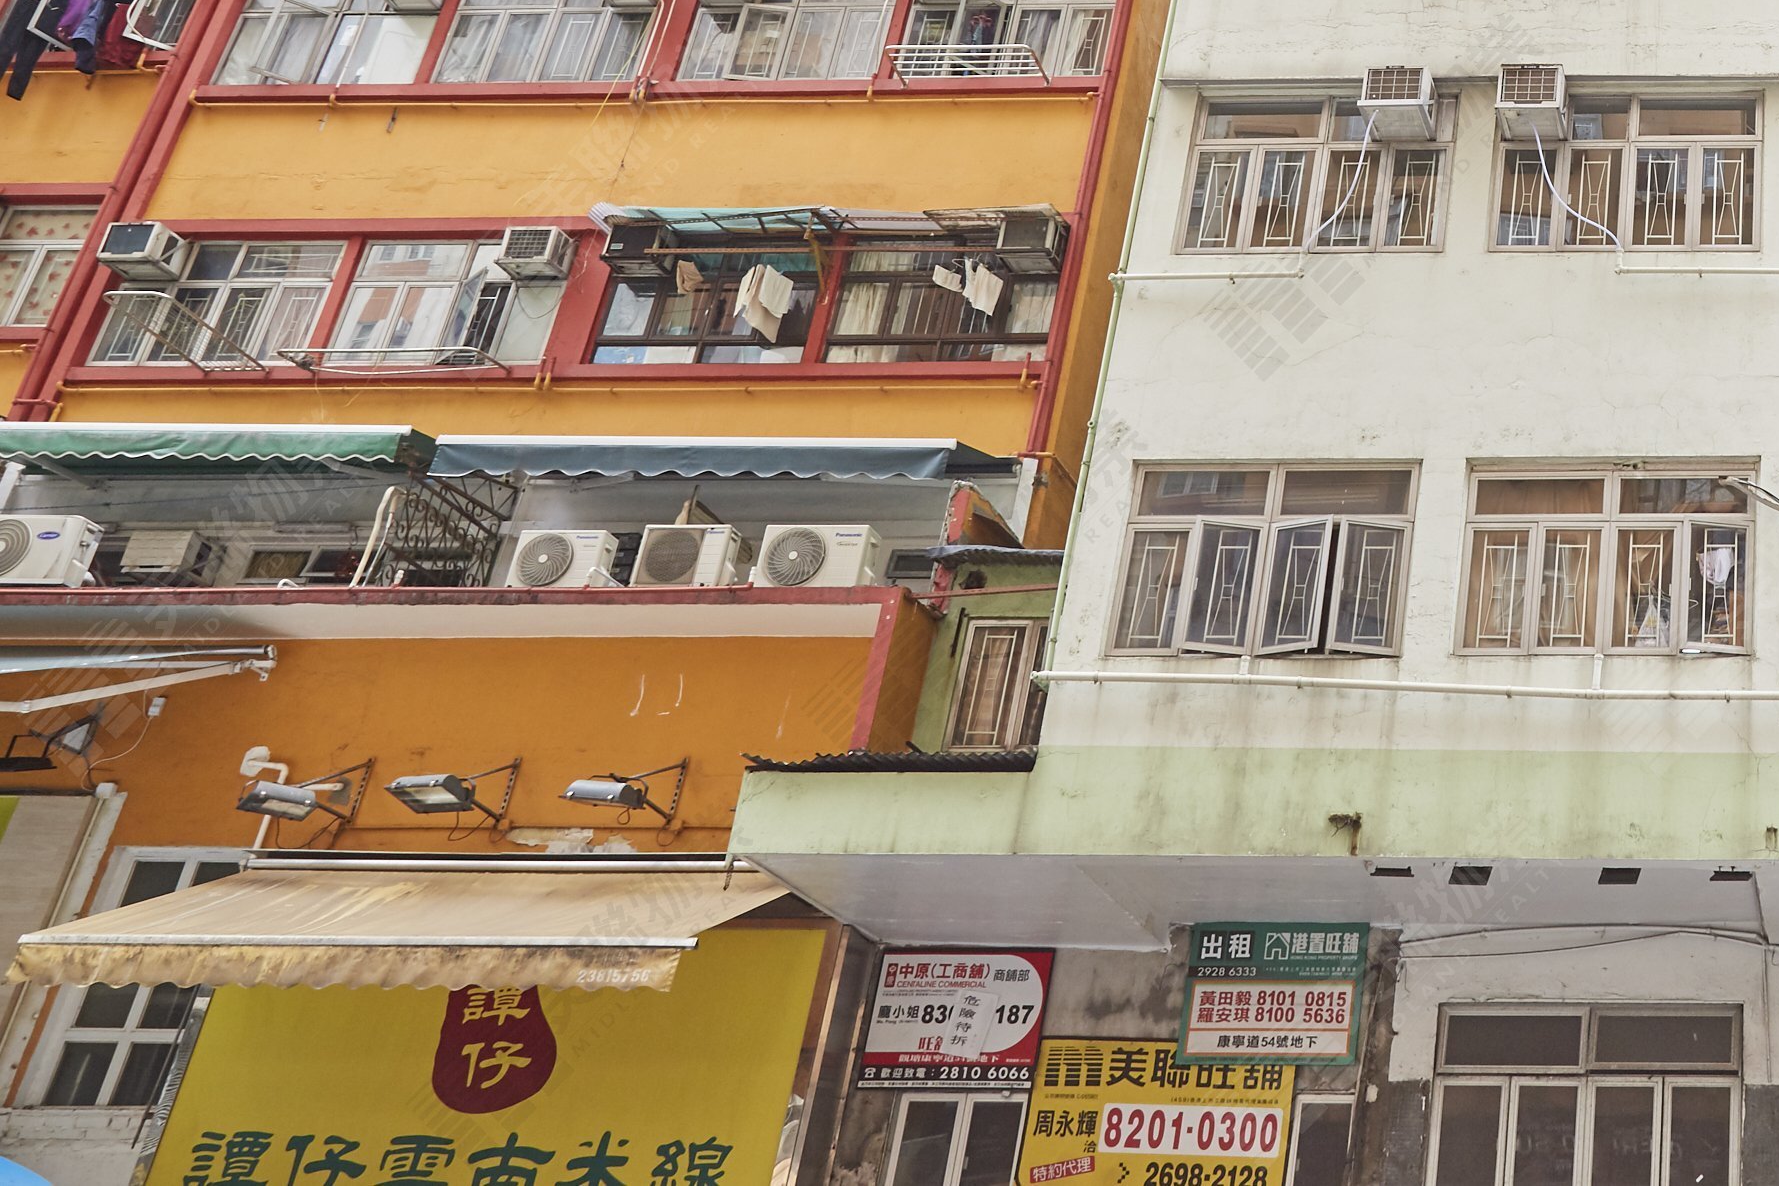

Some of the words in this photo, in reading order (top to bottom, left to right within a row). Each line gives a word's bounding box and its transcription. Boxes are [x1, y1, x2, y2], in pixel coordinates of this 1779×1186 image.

[1200, 933, 1251, 960] 出租
[1197, 966, 1225, 977] 2928
[1228, 966, 1257, 977] 6333
[897, 981, 937, 989] CENTALINE
[938, 981, 987, 989] COMMERCIAL
[1257, 990, 1296, 1007] 8101
[1305, 991, 1347, 1007] 0815
[1254, 1007, 1295, 1023] 8100
[1302, 1008, 1345, 1024] 5636
[939, 1066, 981, 1079] 2810
[987, 1067, 1029, 1079] 6066
